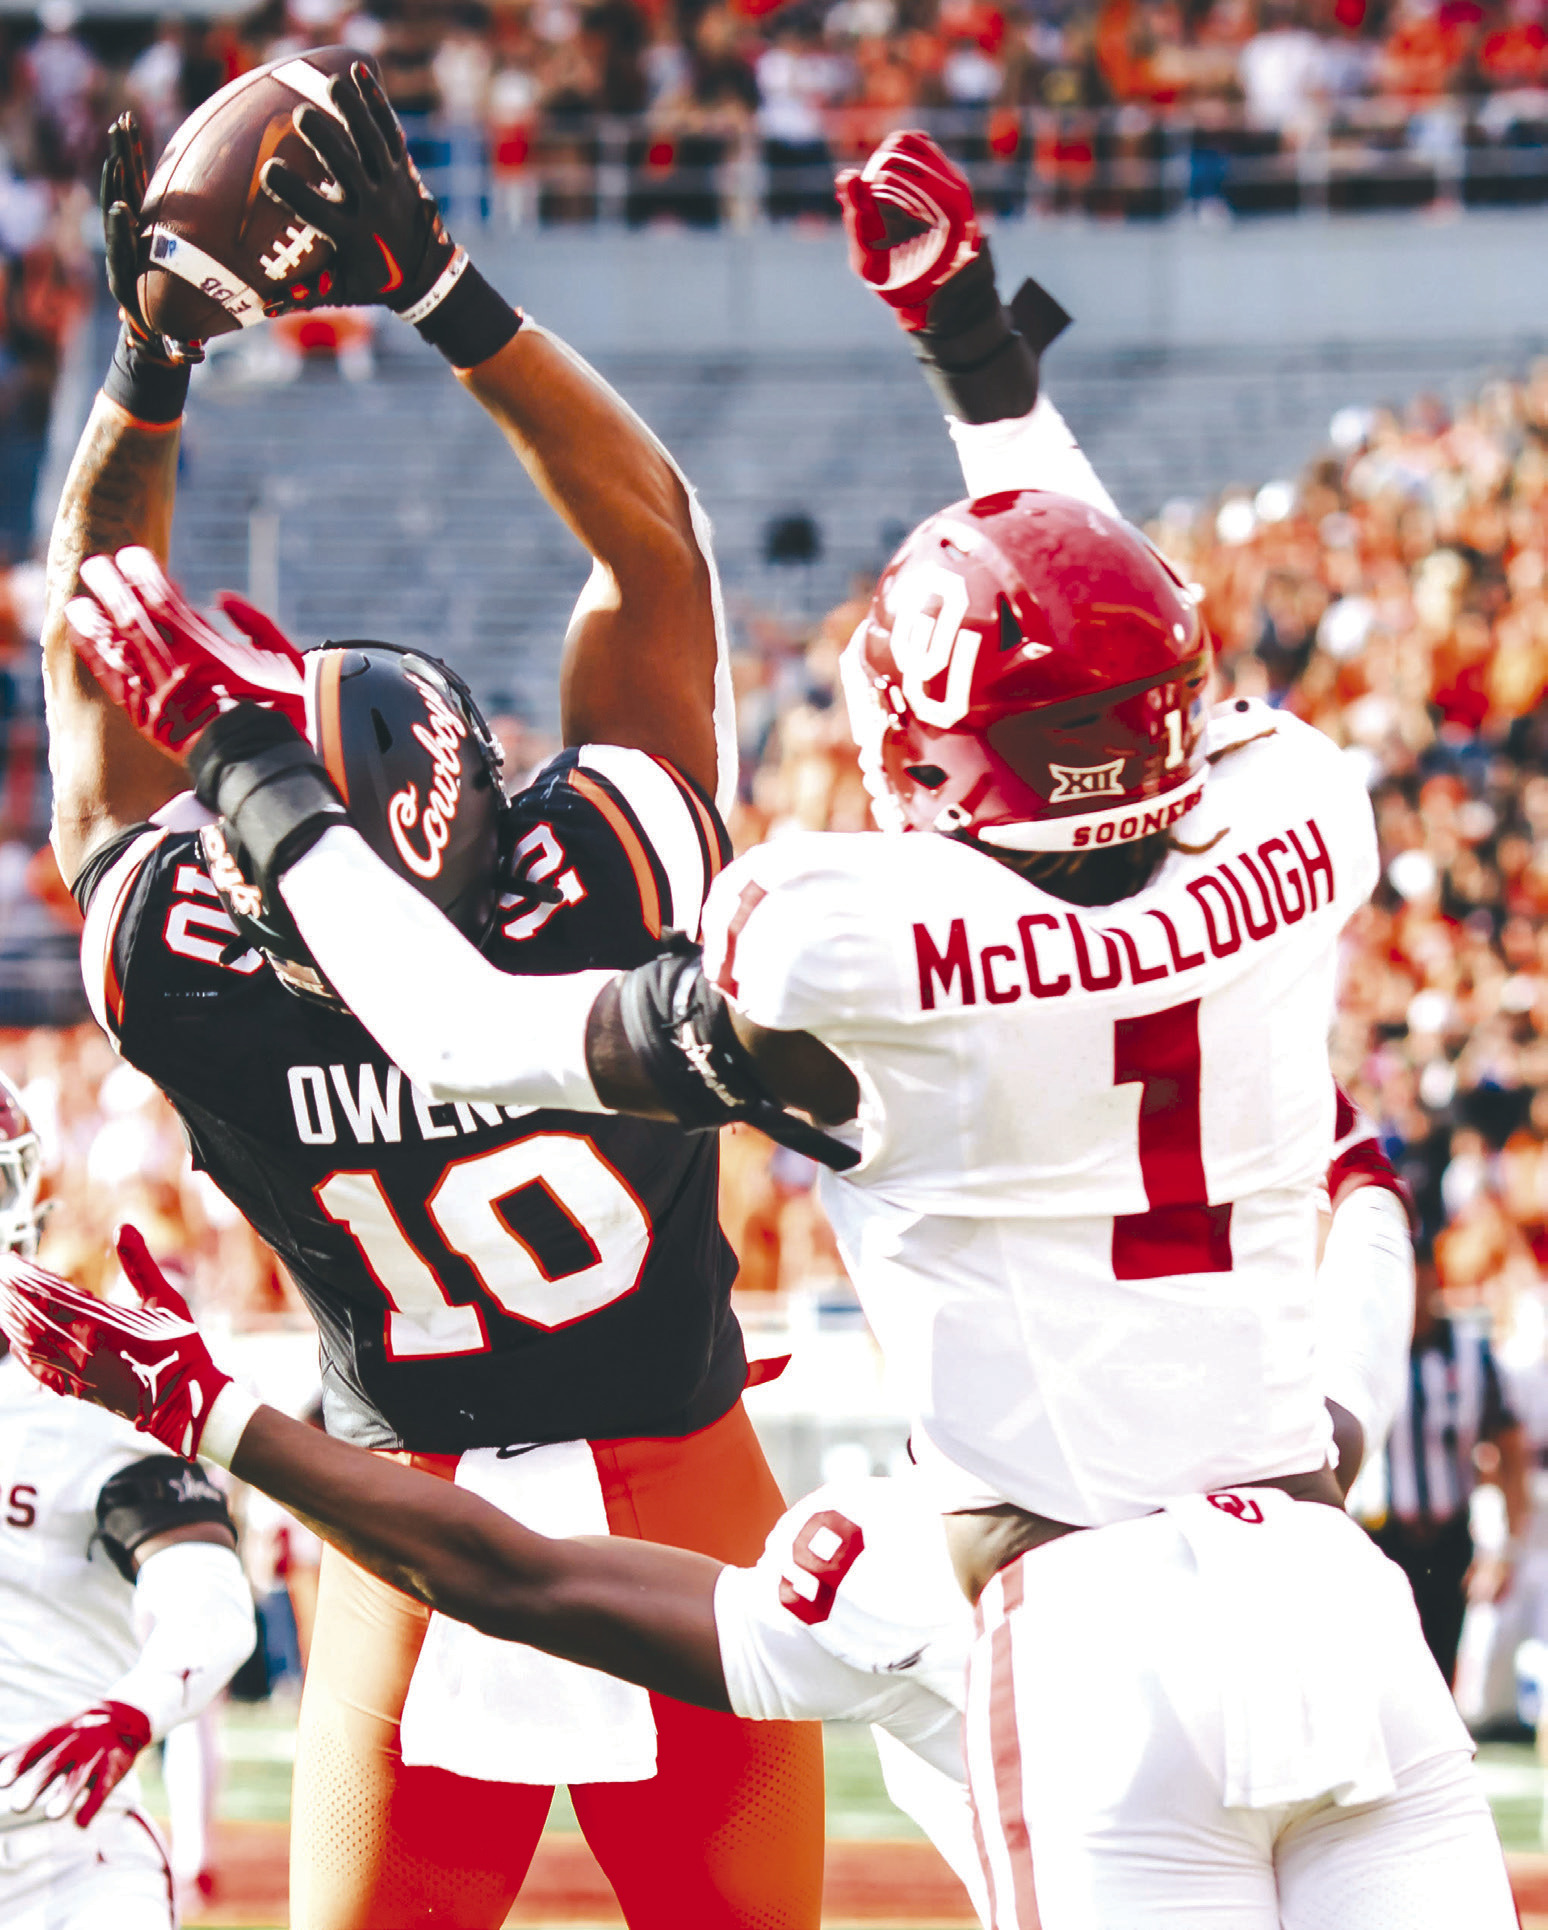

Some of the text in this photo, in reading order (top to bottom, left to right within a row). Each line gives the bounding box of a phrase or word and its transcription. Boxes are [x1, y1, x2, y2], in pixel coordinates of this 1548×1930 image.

[888, 562, 983, 730] OU
[1164, 708, 1186, 770] 1
[286, 1062, 540, 1145] OWE
[1111, 996, 1234, 1281] 1
[311, 1130, 654, 1363] 10
[778, 1509, 866, 1626] 9
[1206, 1493, 1265, 1525] OU
